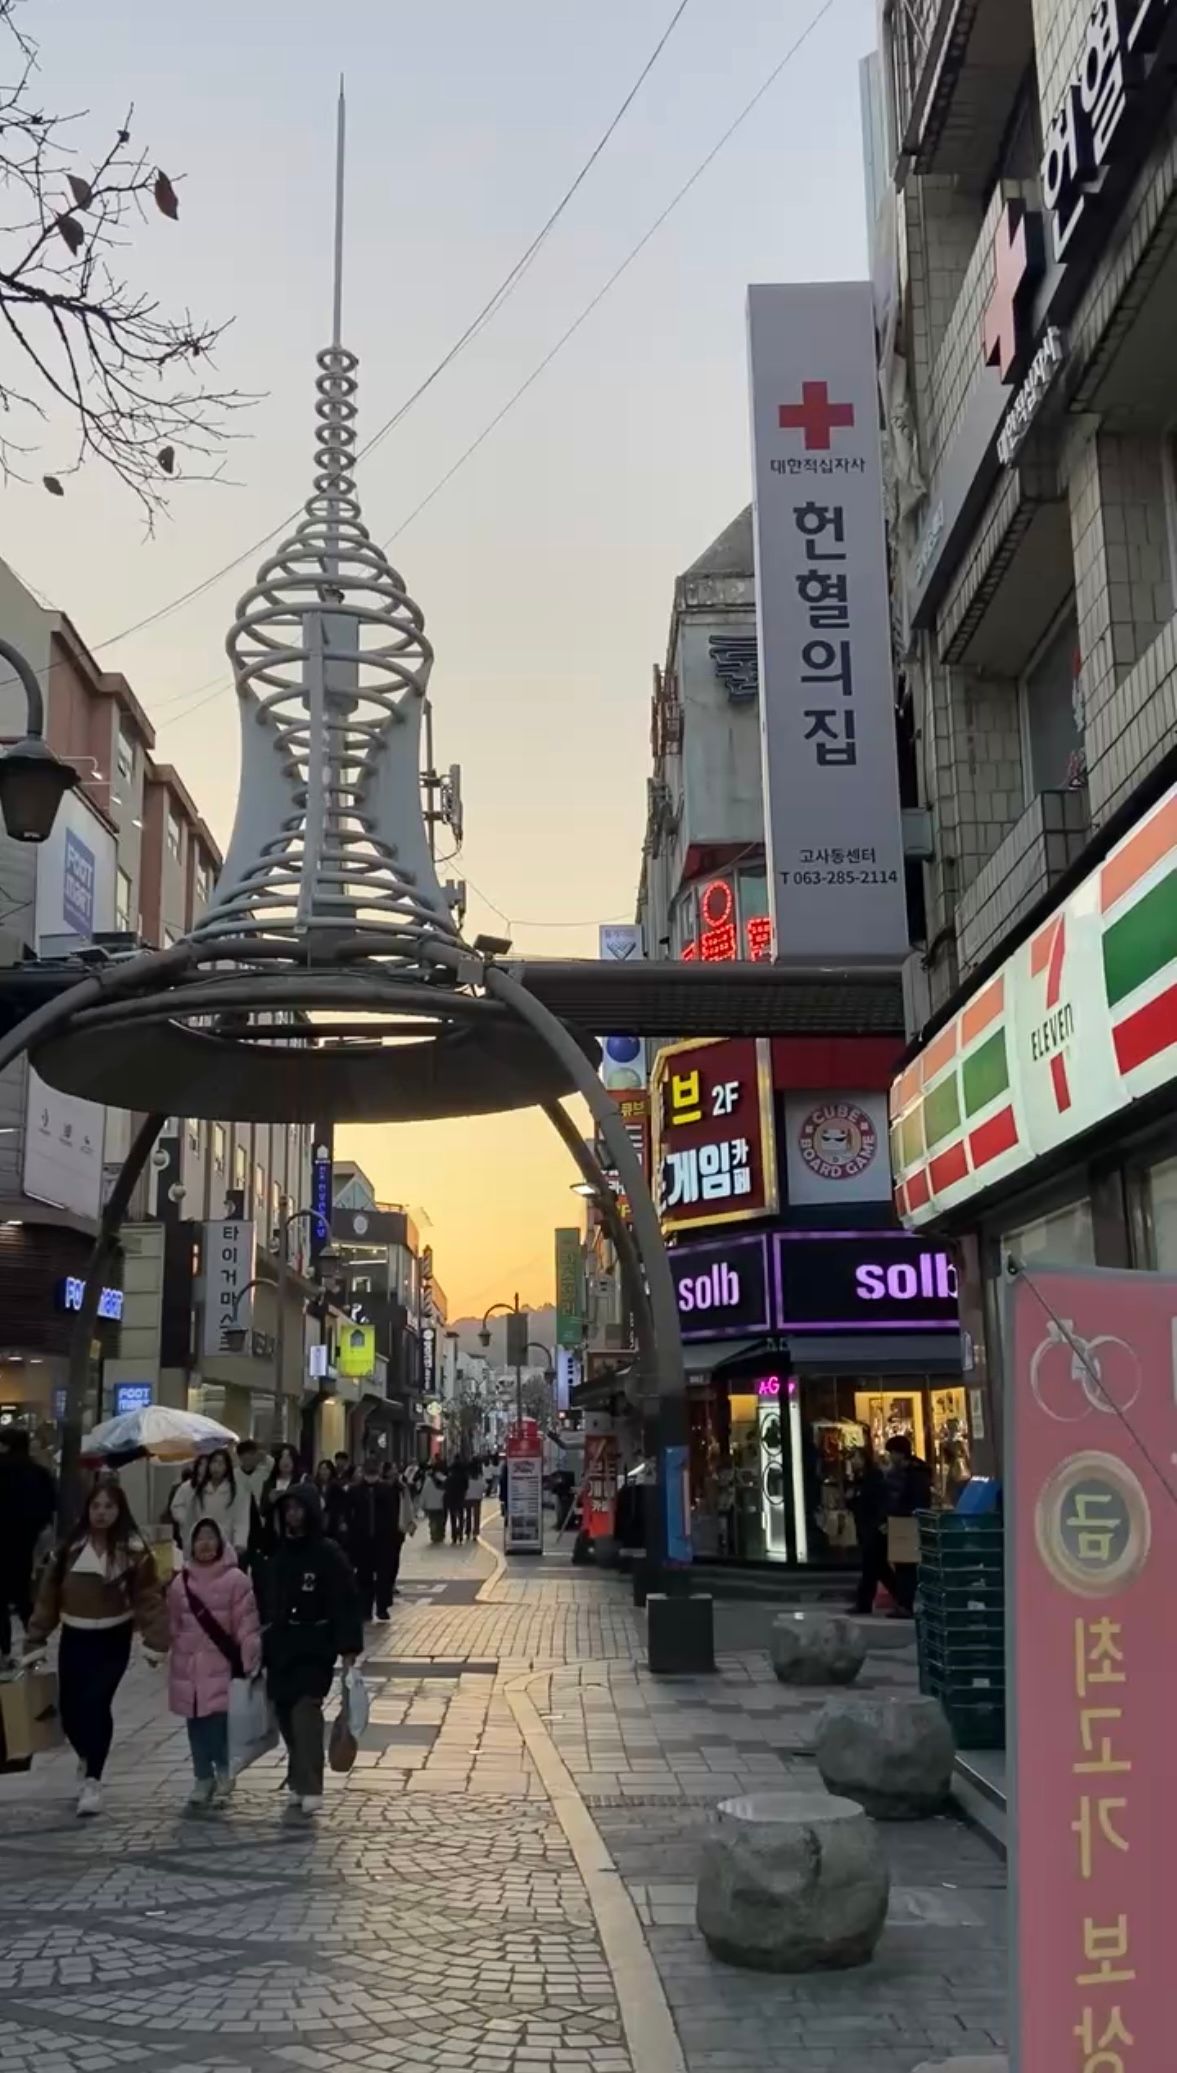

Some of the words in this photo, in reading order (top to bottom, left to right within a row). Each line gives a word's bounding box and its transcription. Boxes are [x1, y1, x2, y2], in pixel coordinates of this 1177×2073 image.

[770, 458, 865, 474] 대한적십자사
[800, 848, 876, 865] 고사동센터
[780, 871, 789, 885] T
[793, 870, 898, 885] 063-285-2114
[711, 1081, 740, 1116] 2F
[812, 1105, 861, 1124] CUBE
[801, 1138, 842, 1177] BOARD
[845, 1135, 875, 1174] GAME
[678, 1262, 740, 1312] solb
